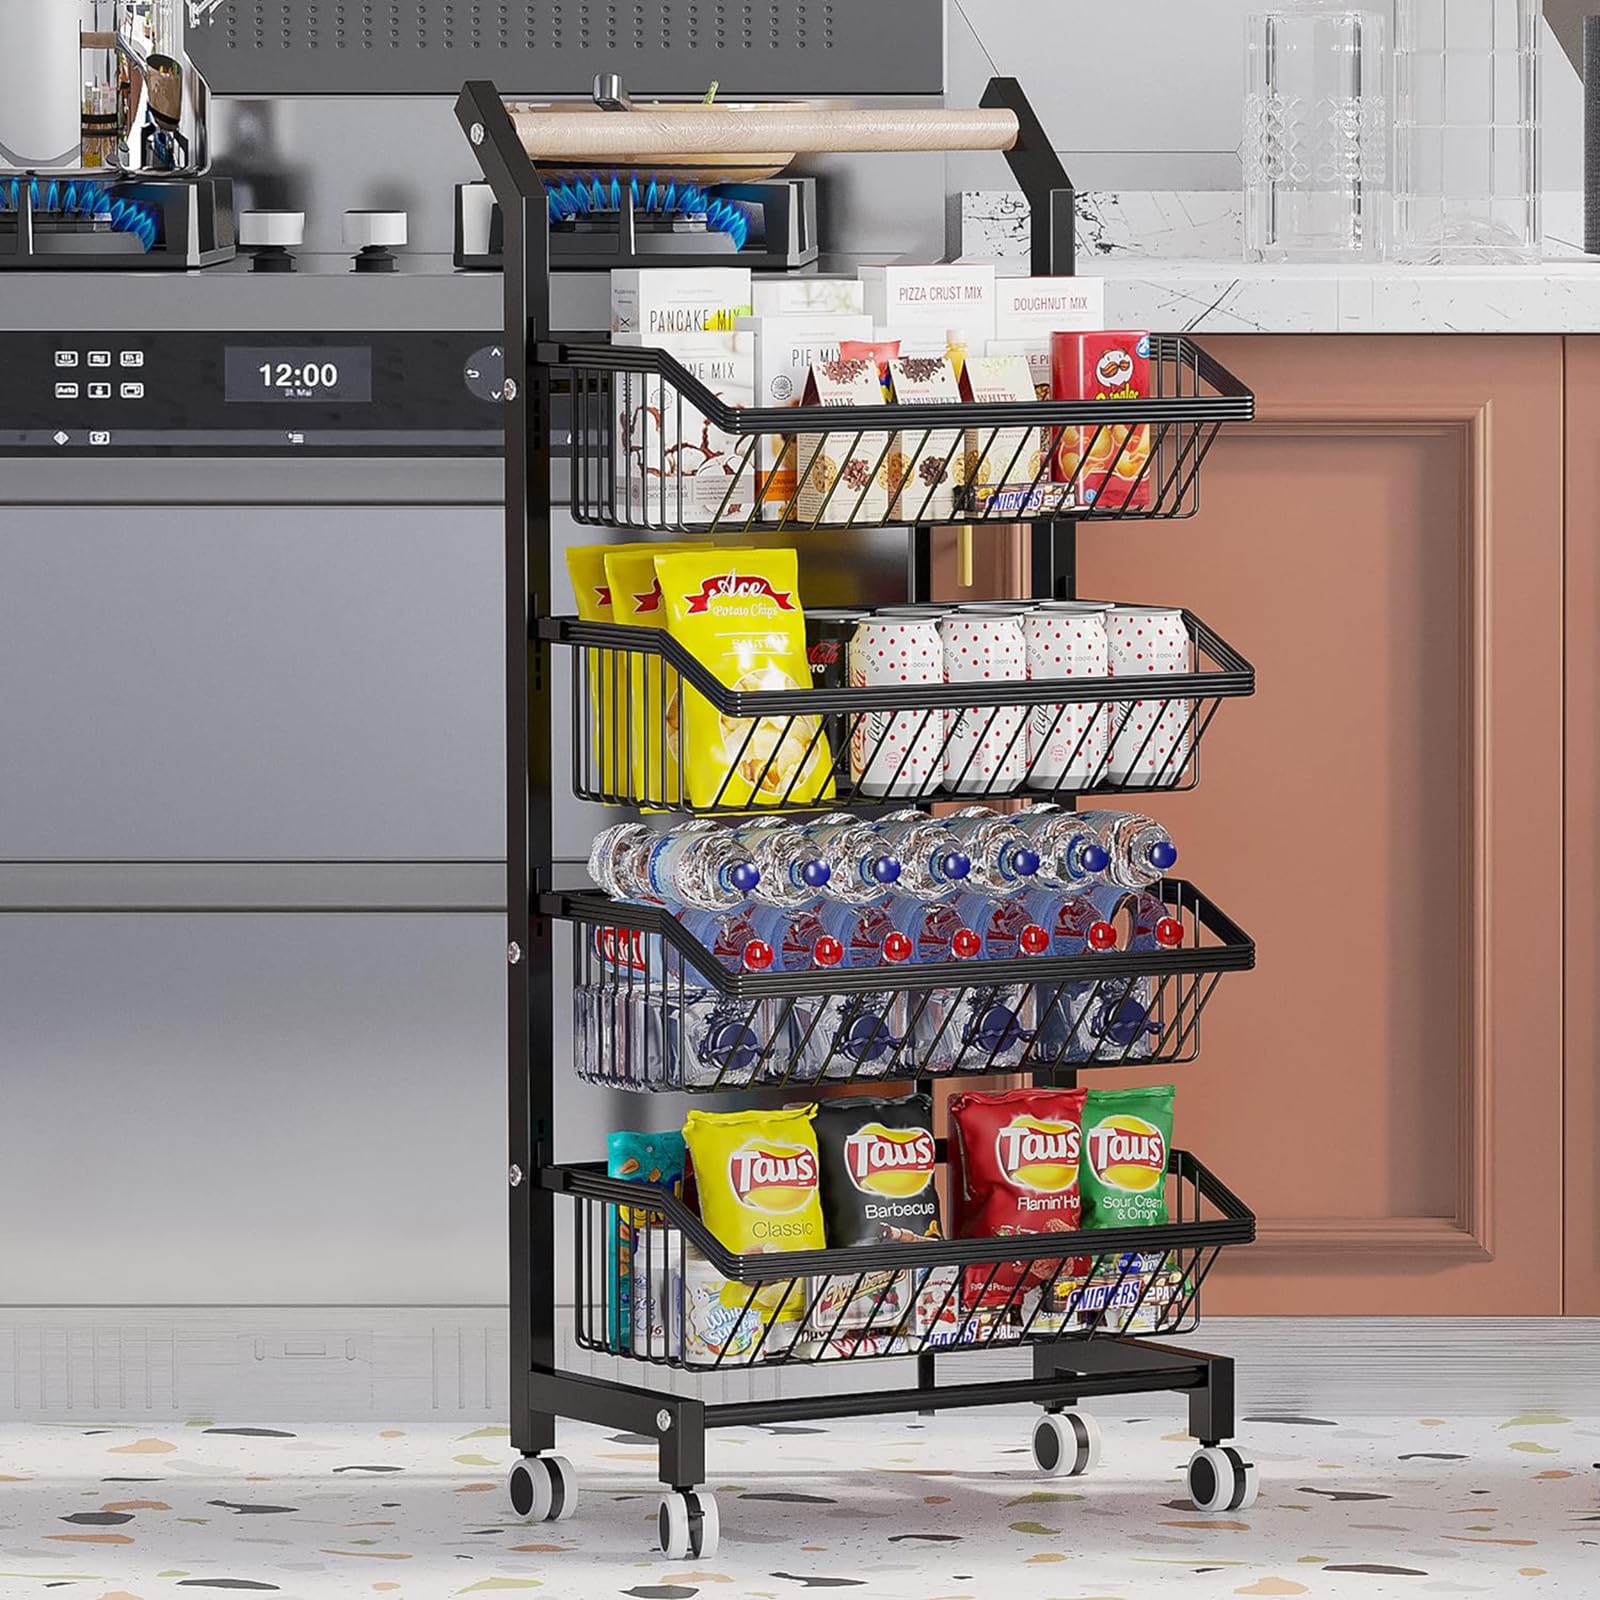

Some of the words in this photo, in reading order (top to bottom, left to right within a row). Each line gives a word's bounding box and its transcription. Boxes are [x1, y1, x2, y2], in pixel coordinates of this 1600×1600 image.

[899, 286, 927, 301] PIZZA
[929, 285, 961, 300] CRUST
[964, 285, 983, 300] MIX
[1014, 297, 1066, 311] DOUGHNUT
[1070, 296, 1088, 310] MIX
[650, 309, 709, 333] PANCAKE
[791, 348, 812, 367] PIE
[259, 363, 338, 387] 12:00
[711, 361, 735, 379] MIX
[708, 567, 767, 597] Ace
[714, 605, 749, 617] Potato
[750, 602, 778, 619] Chips
[847, 1134, 931, 1177] Taus
[1000, 1127, 1080, 1171] Taus
[1089, 1128, 1161, 1170] Taus
[731, 1150, 815, 1192] Taus
[865, 1202, 935, 1219] Barbecue
[1103, 1196, 1131, 1209] Sour
[1117, 1209, 1126, 1220] &
[752, 1221, 814, 1239] Classic
